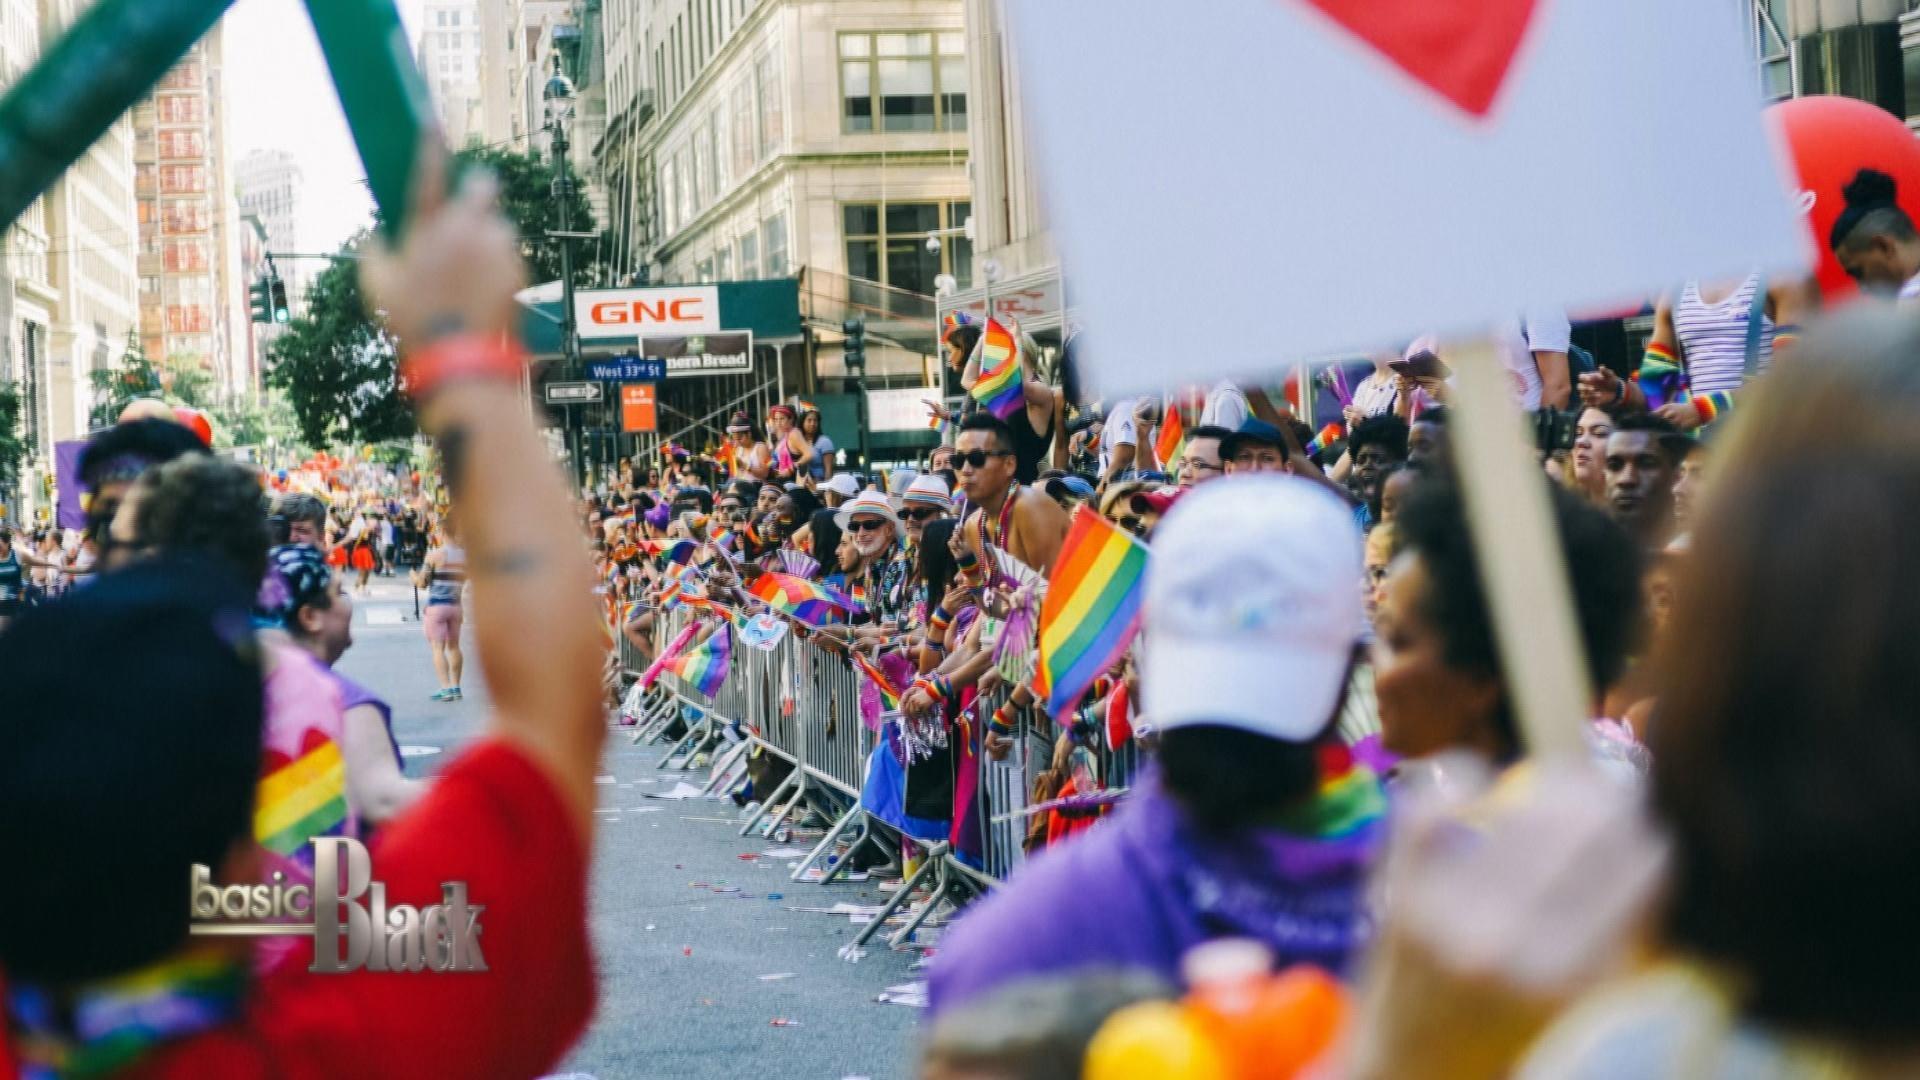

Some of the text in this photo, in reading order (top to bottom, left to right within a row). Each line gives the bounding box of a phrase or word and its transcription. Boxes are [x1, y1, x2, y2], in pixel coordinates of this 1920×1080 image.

[591, 298, 704, 324] GNC
[664, 352, 747, 369] nera Bread
[593, 365, 622, 378] West
[648, 364, 660, 377] St
